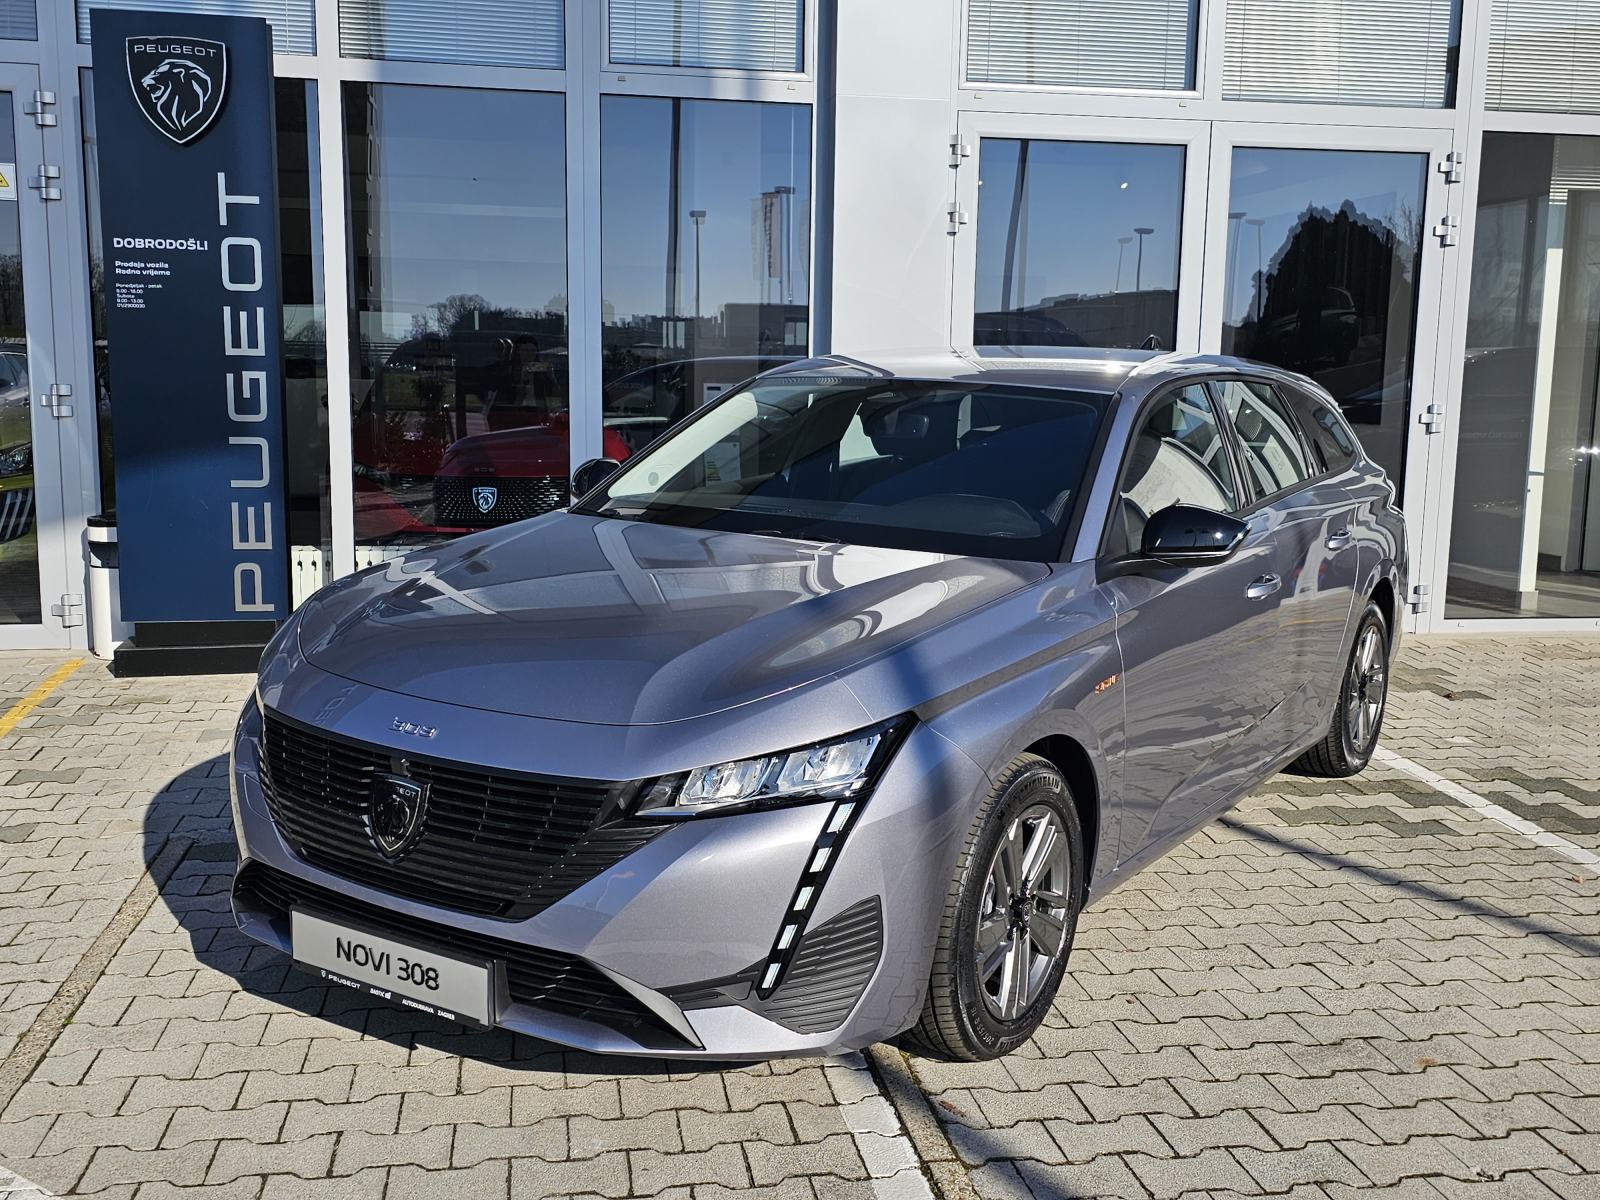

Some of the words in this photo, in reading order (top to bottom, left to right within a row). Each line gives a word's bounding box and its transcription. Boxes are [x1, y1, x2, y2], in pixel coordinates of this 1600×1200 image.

[134, 44, 217, 57] PEUGEOT
[113, 237, 208, 251] DOBRODOŠLI
[217, 171, 275, 612] PEUGEOT
[336, 937, 391, 976] NOVI
[396, 957, 440, 991] 308
[328, 974, 361, 990] PEUGEOT
